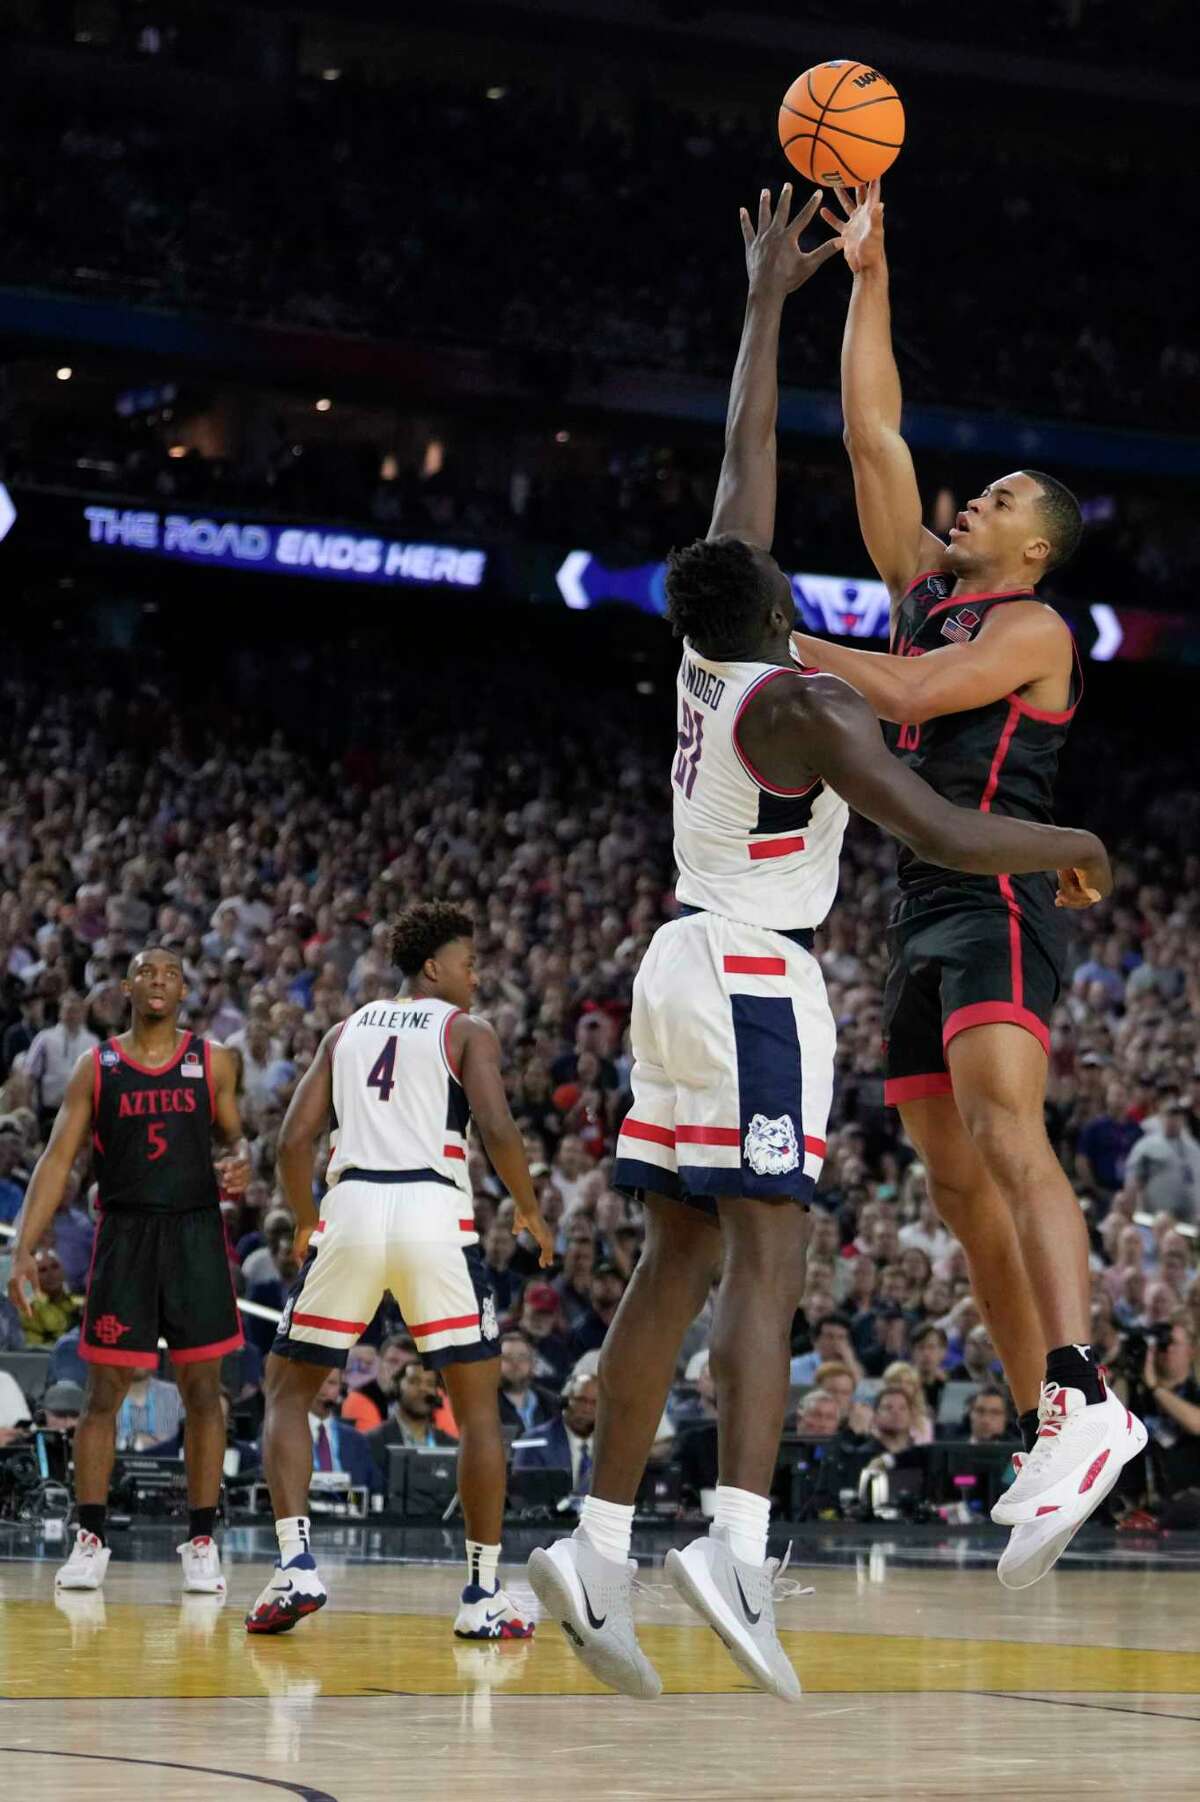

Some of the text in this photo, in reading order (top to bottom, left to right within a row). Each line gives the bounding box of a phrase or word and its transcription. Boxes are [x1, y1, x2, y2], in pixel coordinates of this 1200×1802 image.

[84, 506, 487, 586] THE ROAD ENDS HERE
[356, 1009, 433, 1030] ALLEYNE
[366, 1035, 399, 1102] 4
[118, 1088, 198, 1118] AZTECS
[145, 1120, 168, 1161] 5
